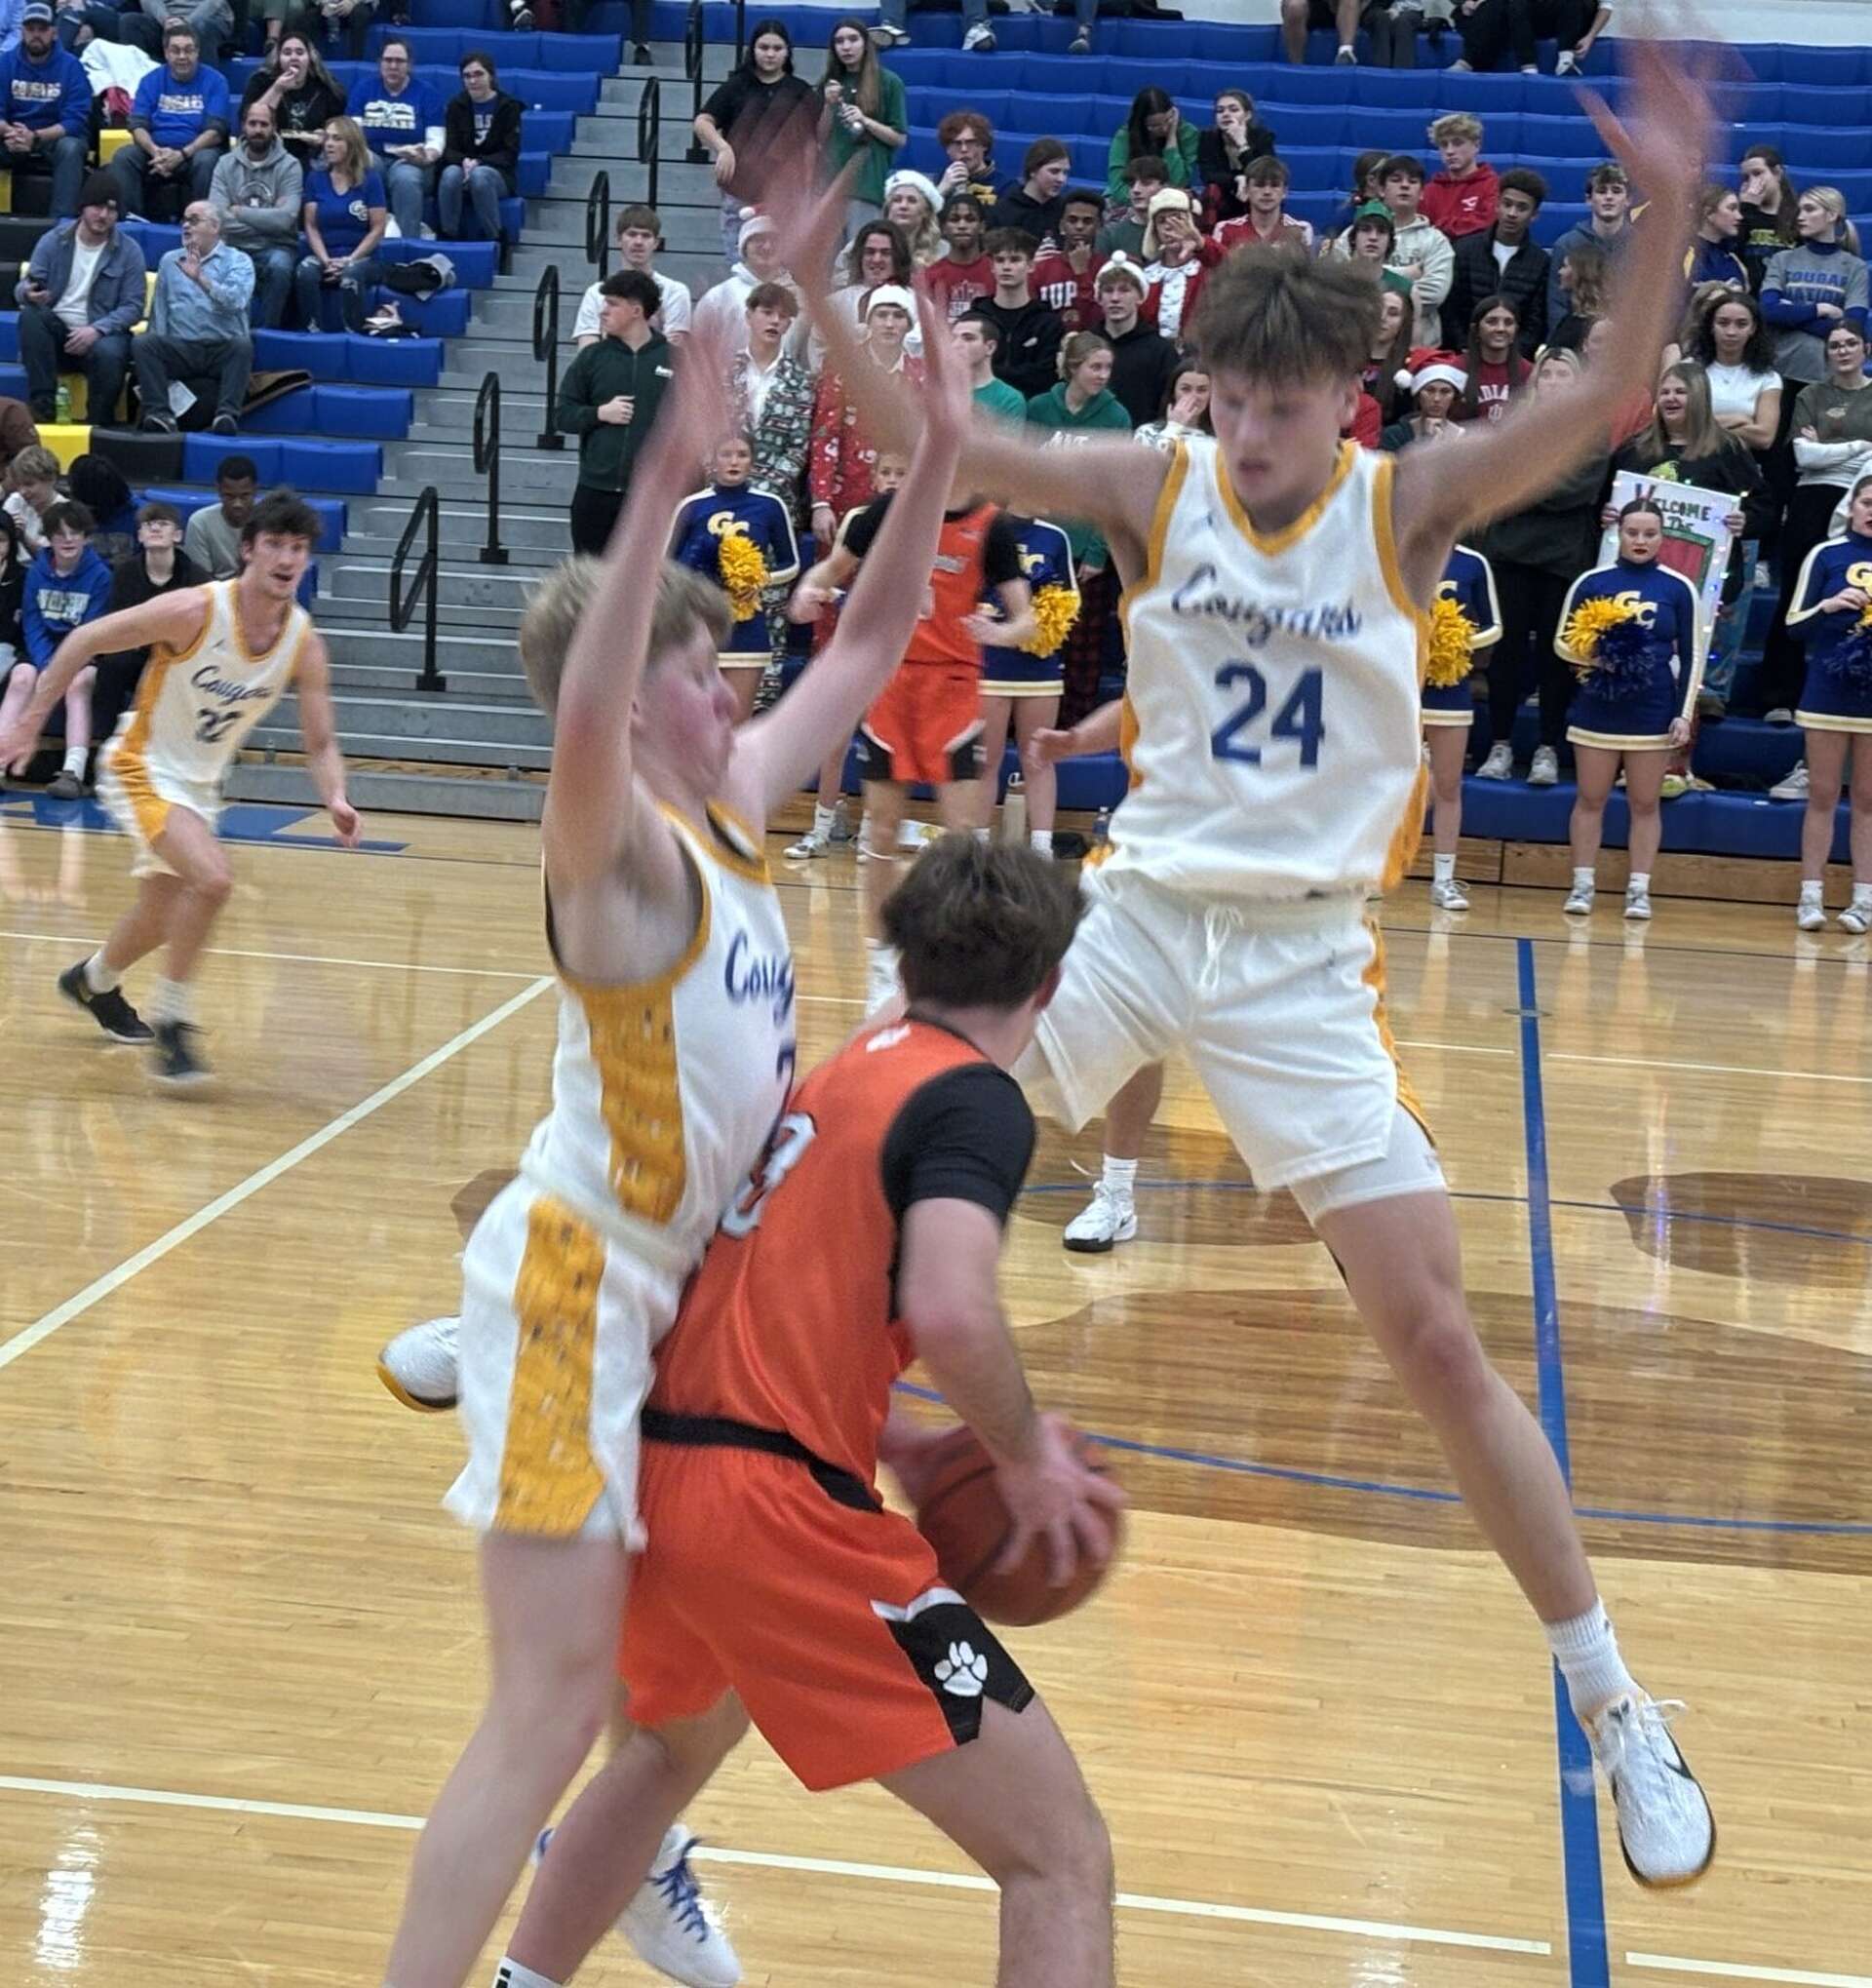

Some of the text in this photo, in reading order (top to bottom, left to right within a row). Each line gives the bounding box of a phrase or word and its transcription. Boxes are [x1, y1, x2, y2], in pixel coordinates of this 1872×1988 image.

[1171, 562, 1363, 649] Cougars
[1613, 589, 1658, 631] GC
[1210, 658, 1326, 772] 24
